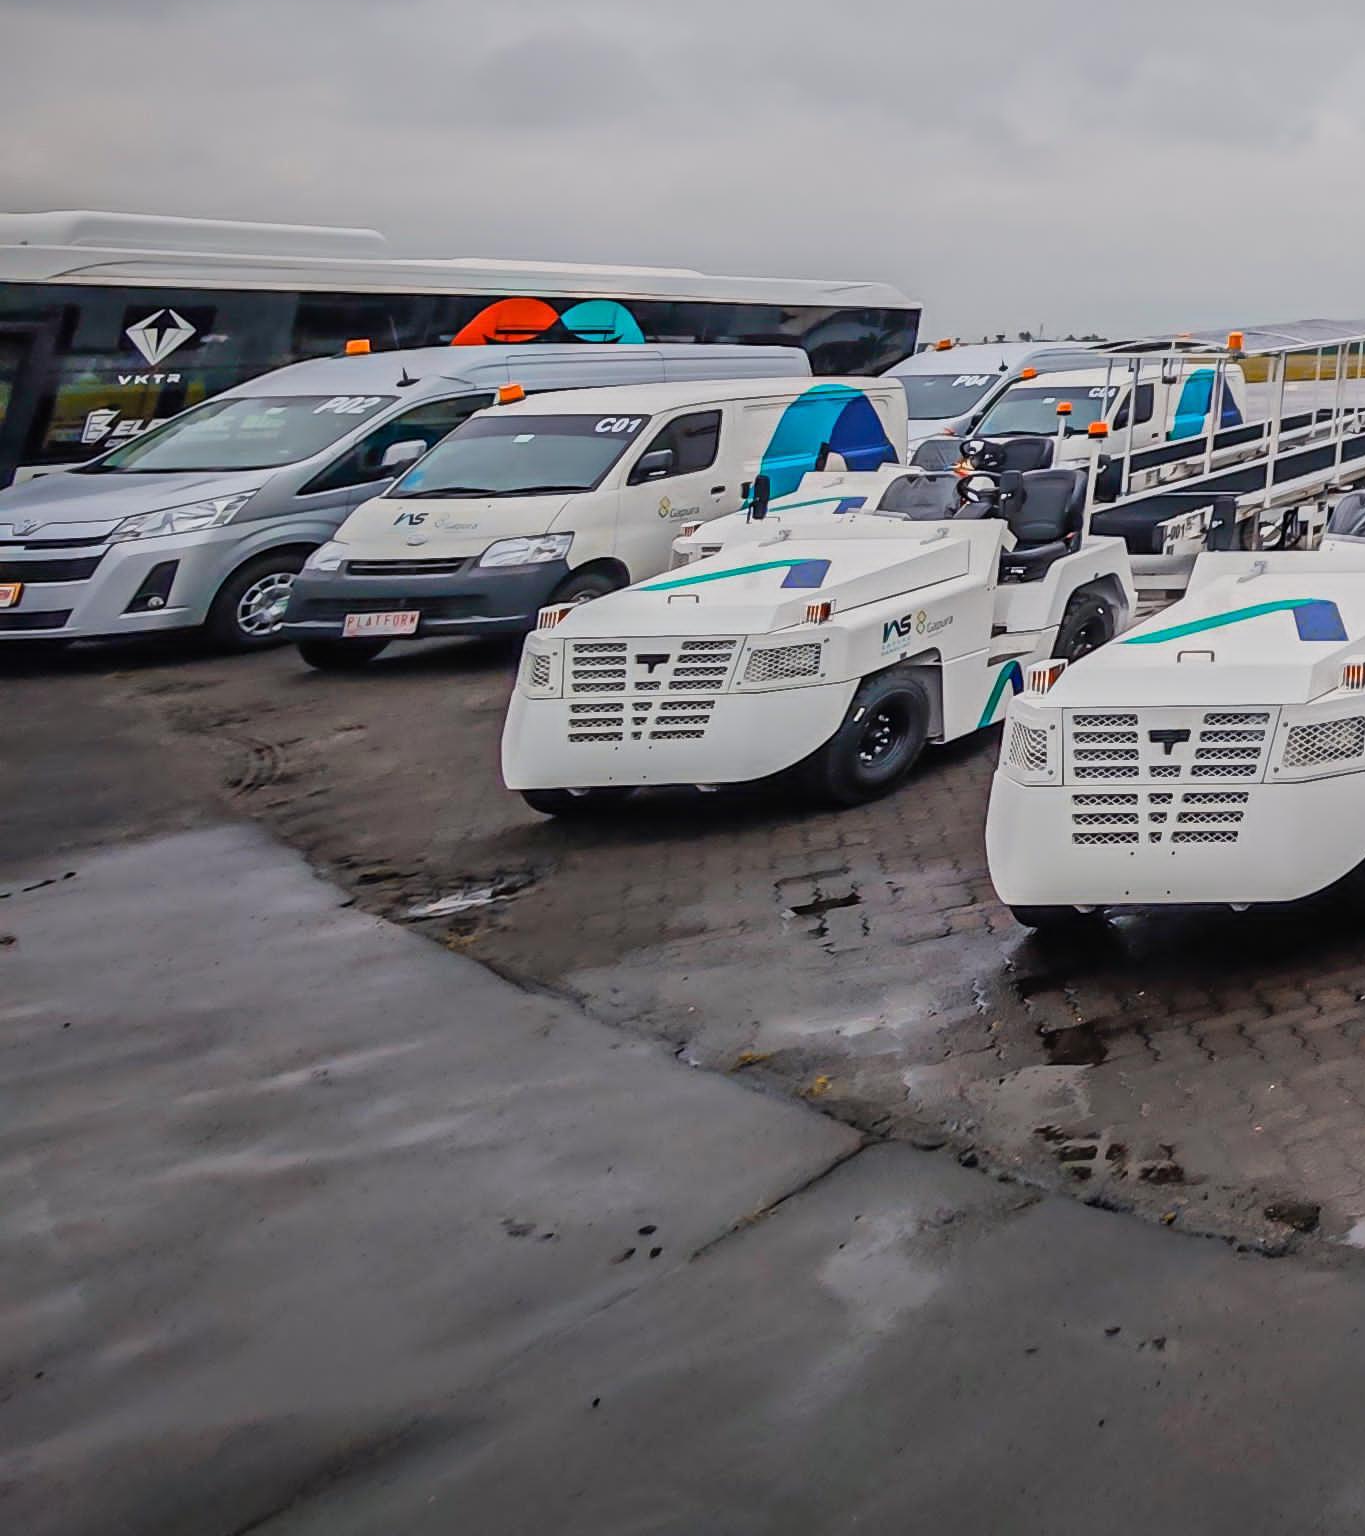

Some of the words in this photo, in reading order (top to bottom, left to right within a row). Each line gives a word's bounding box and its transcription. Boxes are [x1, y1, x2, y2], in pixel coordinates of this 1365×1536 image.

[117, 374, 182, 385] VKTR
[312, 396, 382, 415] P02
[595, 417, 643, 433] C01
